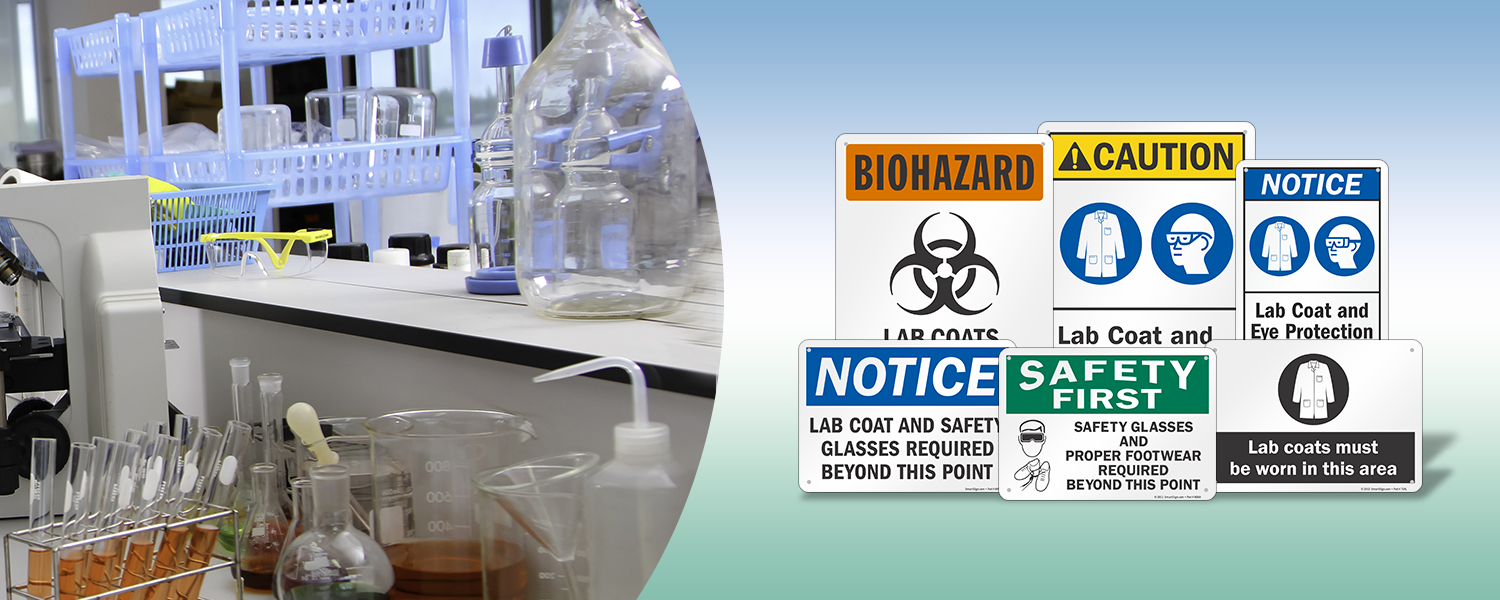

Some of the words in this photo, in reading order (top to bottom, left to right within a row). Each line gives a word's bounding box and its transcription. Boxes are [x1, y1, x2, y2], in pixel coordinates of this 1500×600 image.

[1093, 142, 1233, 171] CAUTION
[855, 154, 1034, 191] BIOHAZARD
[1261, 173, 1363, 195] NOTICE
[1256, 303, 1285, 318] Lab
[1292, 303, 1331, 318] Coat
[1338, 303, 1368, 318] and
[884, 329, 924, 340] LAB
[931, 329, 998, 340] COATS
[1059, 326, 1098, 344] Lab
[1108, 326, 1162, 344] Coat
[1171, 326, 1212, 344] and
[1252, 324, 1278, 339] Eye
[1286, 324, 1373, 339] Protection
[816, 357, 998, 396] NOTICE
[1019, 360, 1196, 390] SAFETY
[1054, 389, 1162, 409] FIRST
[810, 418, 842, 433] LAB
[850, 418, 893, 433] COAT
[898, 418, 934, 433] AND
[1074, 422, 1127, 432] SAFETY
[1131, 422, 1193, 432] GLASSES
[1120, 436, 1148, 446] AND
[1249, 440, 1278, 454] Lab
[1284, 441, 1330, 454] coats
[1336, 441, 1378, 454] must
[822, 441, 899, 456] GLASSES
[907, 441, 994, 459] REQUIRED
[1066, 450, 1121, 461] PROPER
[1126, 450, 1201, 461] FOOTWEAR
[822, 464, 891, 479] BEYOND
[897, 464, 936, 479] THIS
[943, 464, 993, 479] POINT
[1099, 465, 1168, 477] REQUIRED
[1231, 462, 1250, 475] be
[1256, 465, 1296, 475] worn
[1303, 462, 1317, 475] in
[1322, 462, 1354, 475] this
[1360, 465, 1396, 475] area
[1067, 479, 1121, 490] BEYOND
[1125, 479, 1155, 490] THIS
[1161, 479, 1200, 490] POINT
